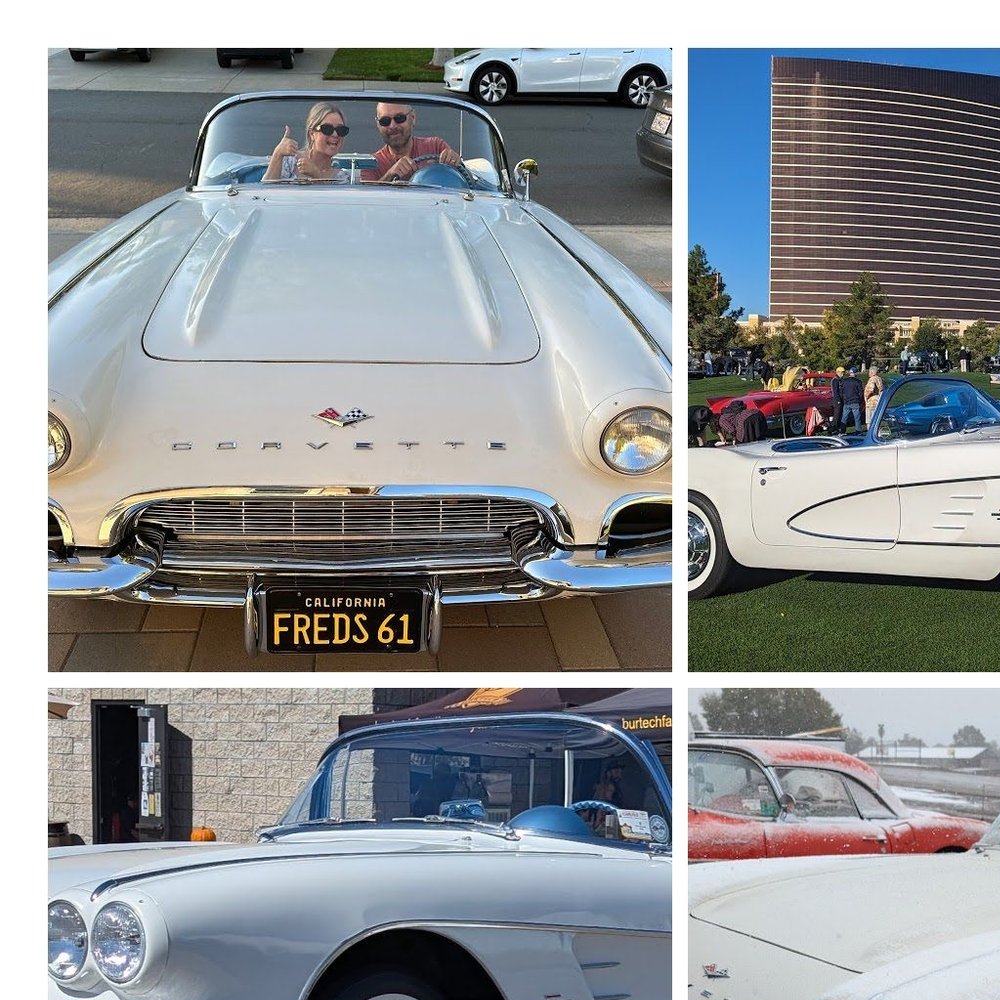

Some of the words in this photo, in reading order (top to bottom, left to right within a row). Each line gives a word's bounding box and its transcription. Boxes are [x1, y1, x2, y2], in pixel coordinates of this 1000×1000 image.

[171, 441, 507, 450] CORVETTE
[305, 597, 386, 608] CALIFORNIA
[273, 612, 369, 645] FREDS
[377, 613, 414, 645] 61
